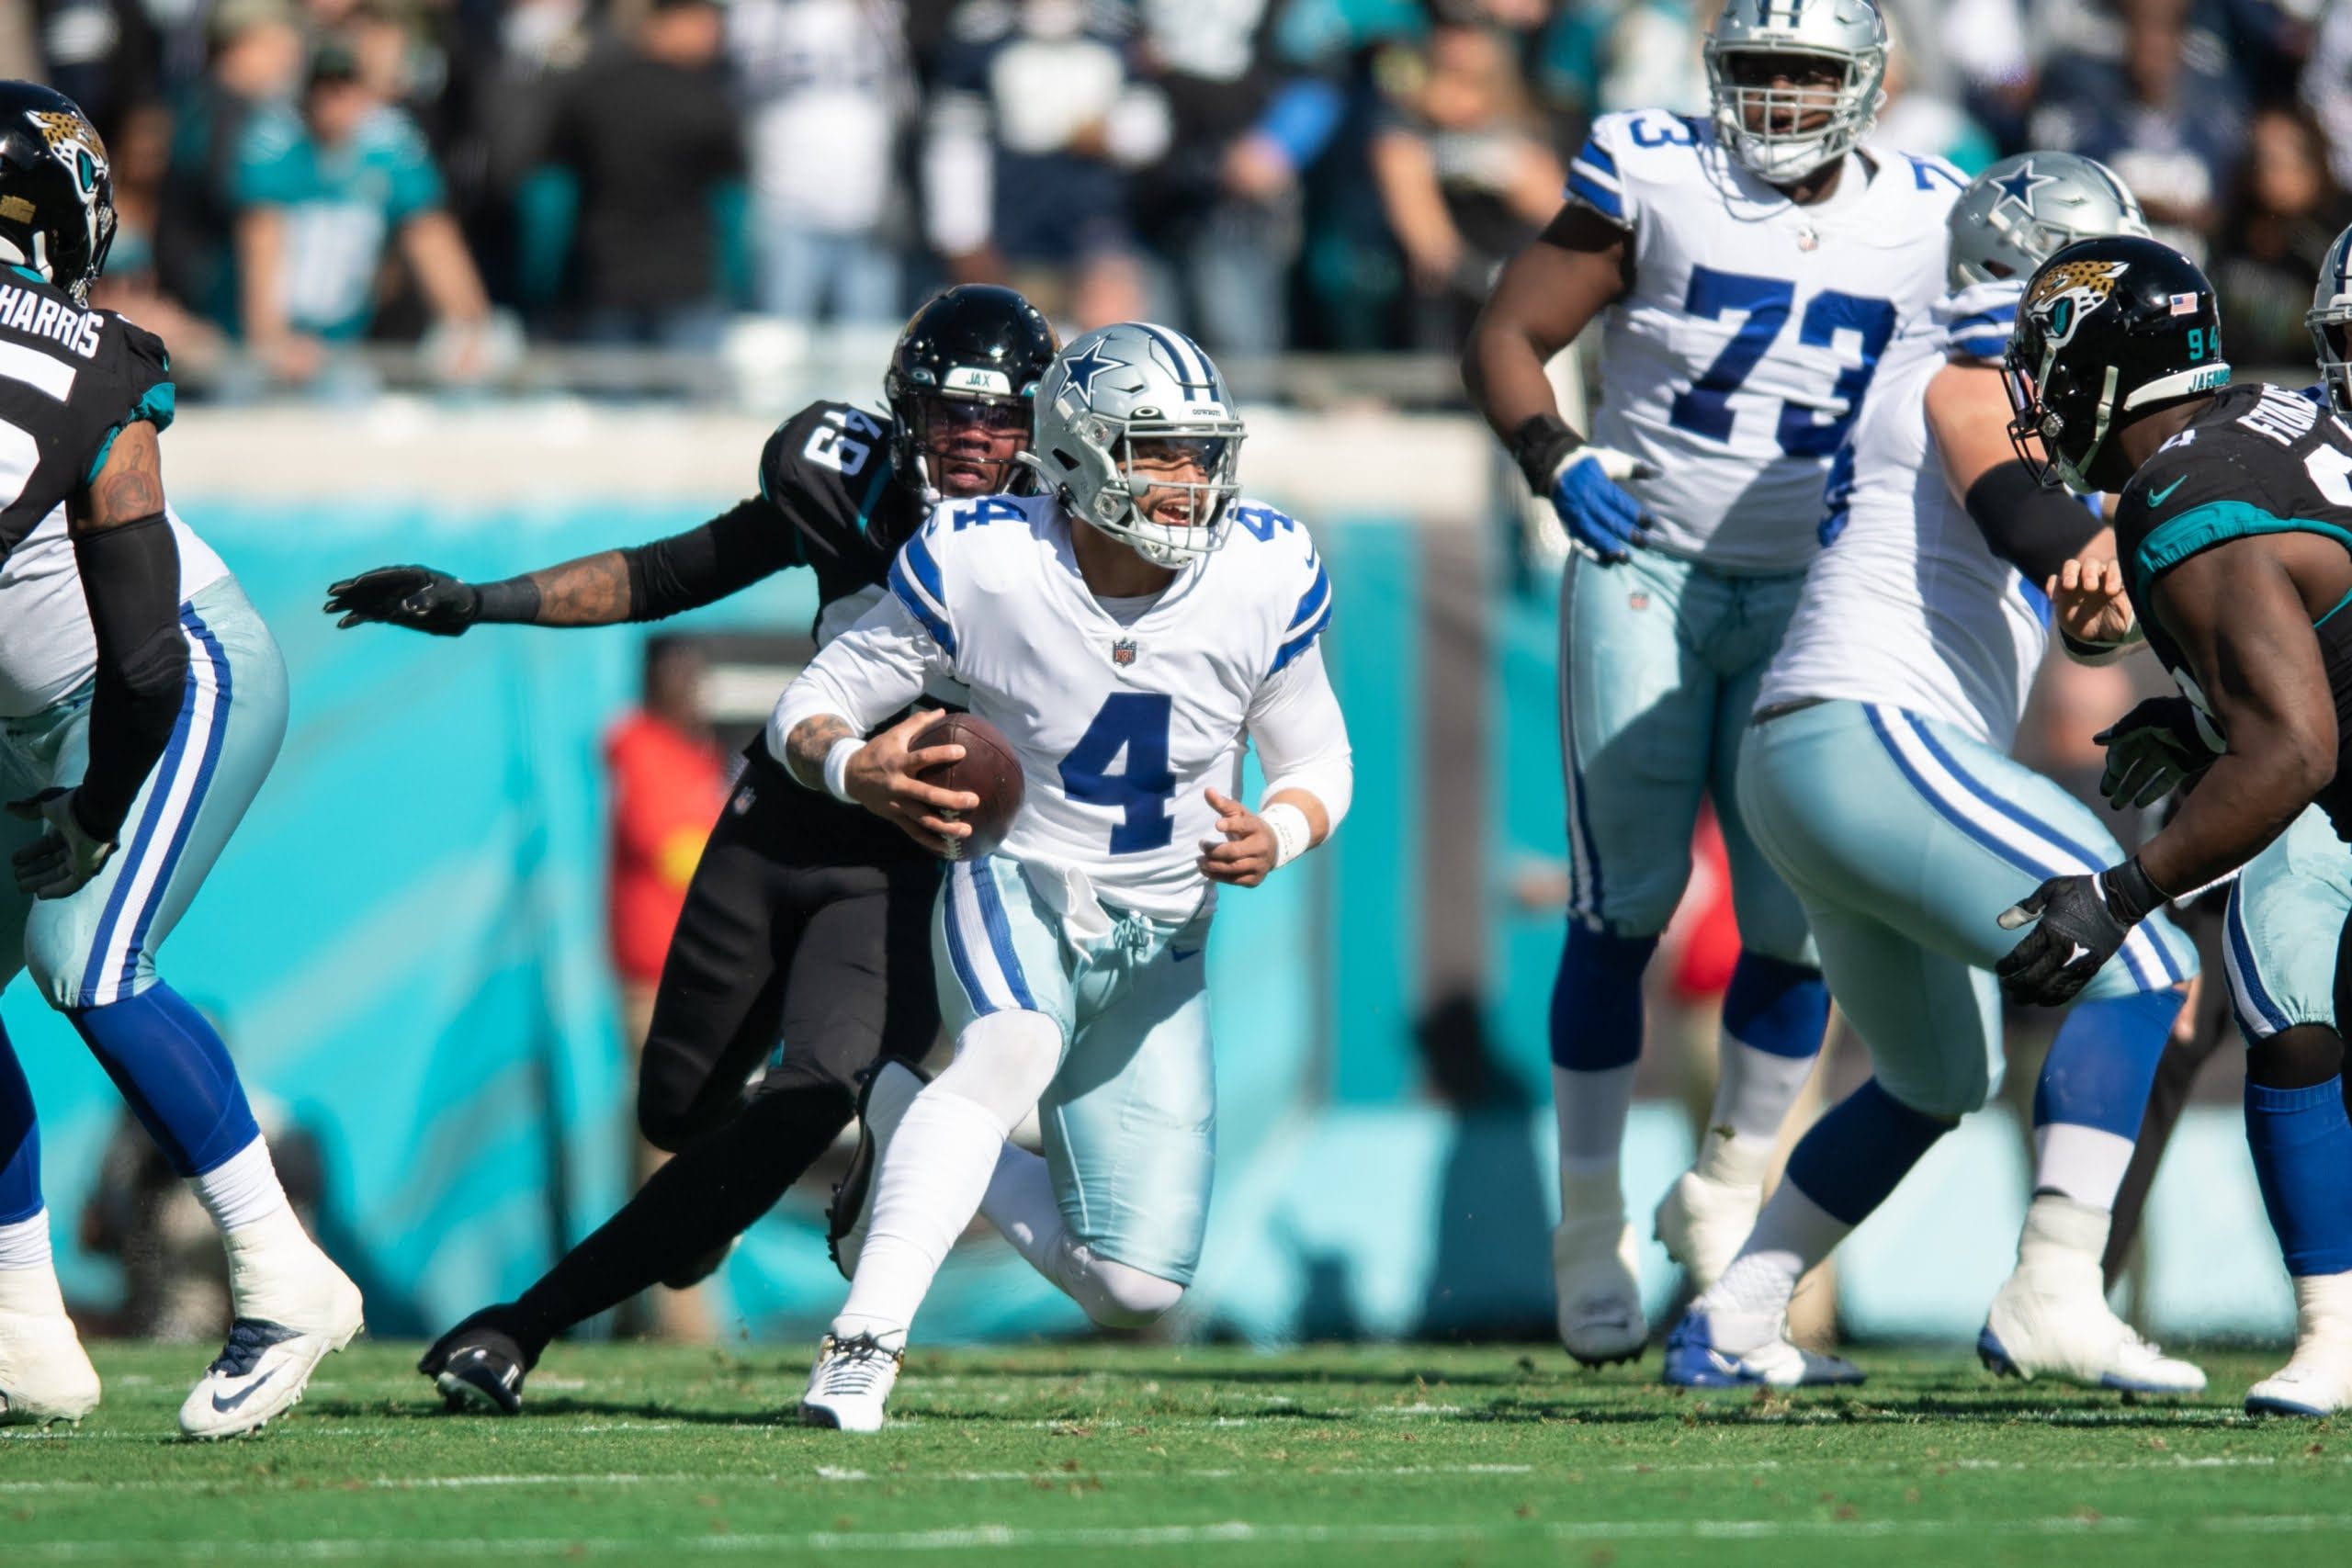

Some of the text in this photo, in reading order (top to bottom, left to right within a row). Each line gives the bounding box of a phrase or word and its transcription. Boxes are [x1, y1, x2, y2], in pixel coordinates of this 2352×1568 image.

[0, 284, 104, 359] HARRIS
[1669, 263, 1898, 457] 73
[2188, 325, 2218, 360] 94
[966, 373, 990, 388] JAX
[953, 498, 1028, 532] 4
[1227, 506, 1295, 544] 4
[1057, 692, 1178, 856] 4
